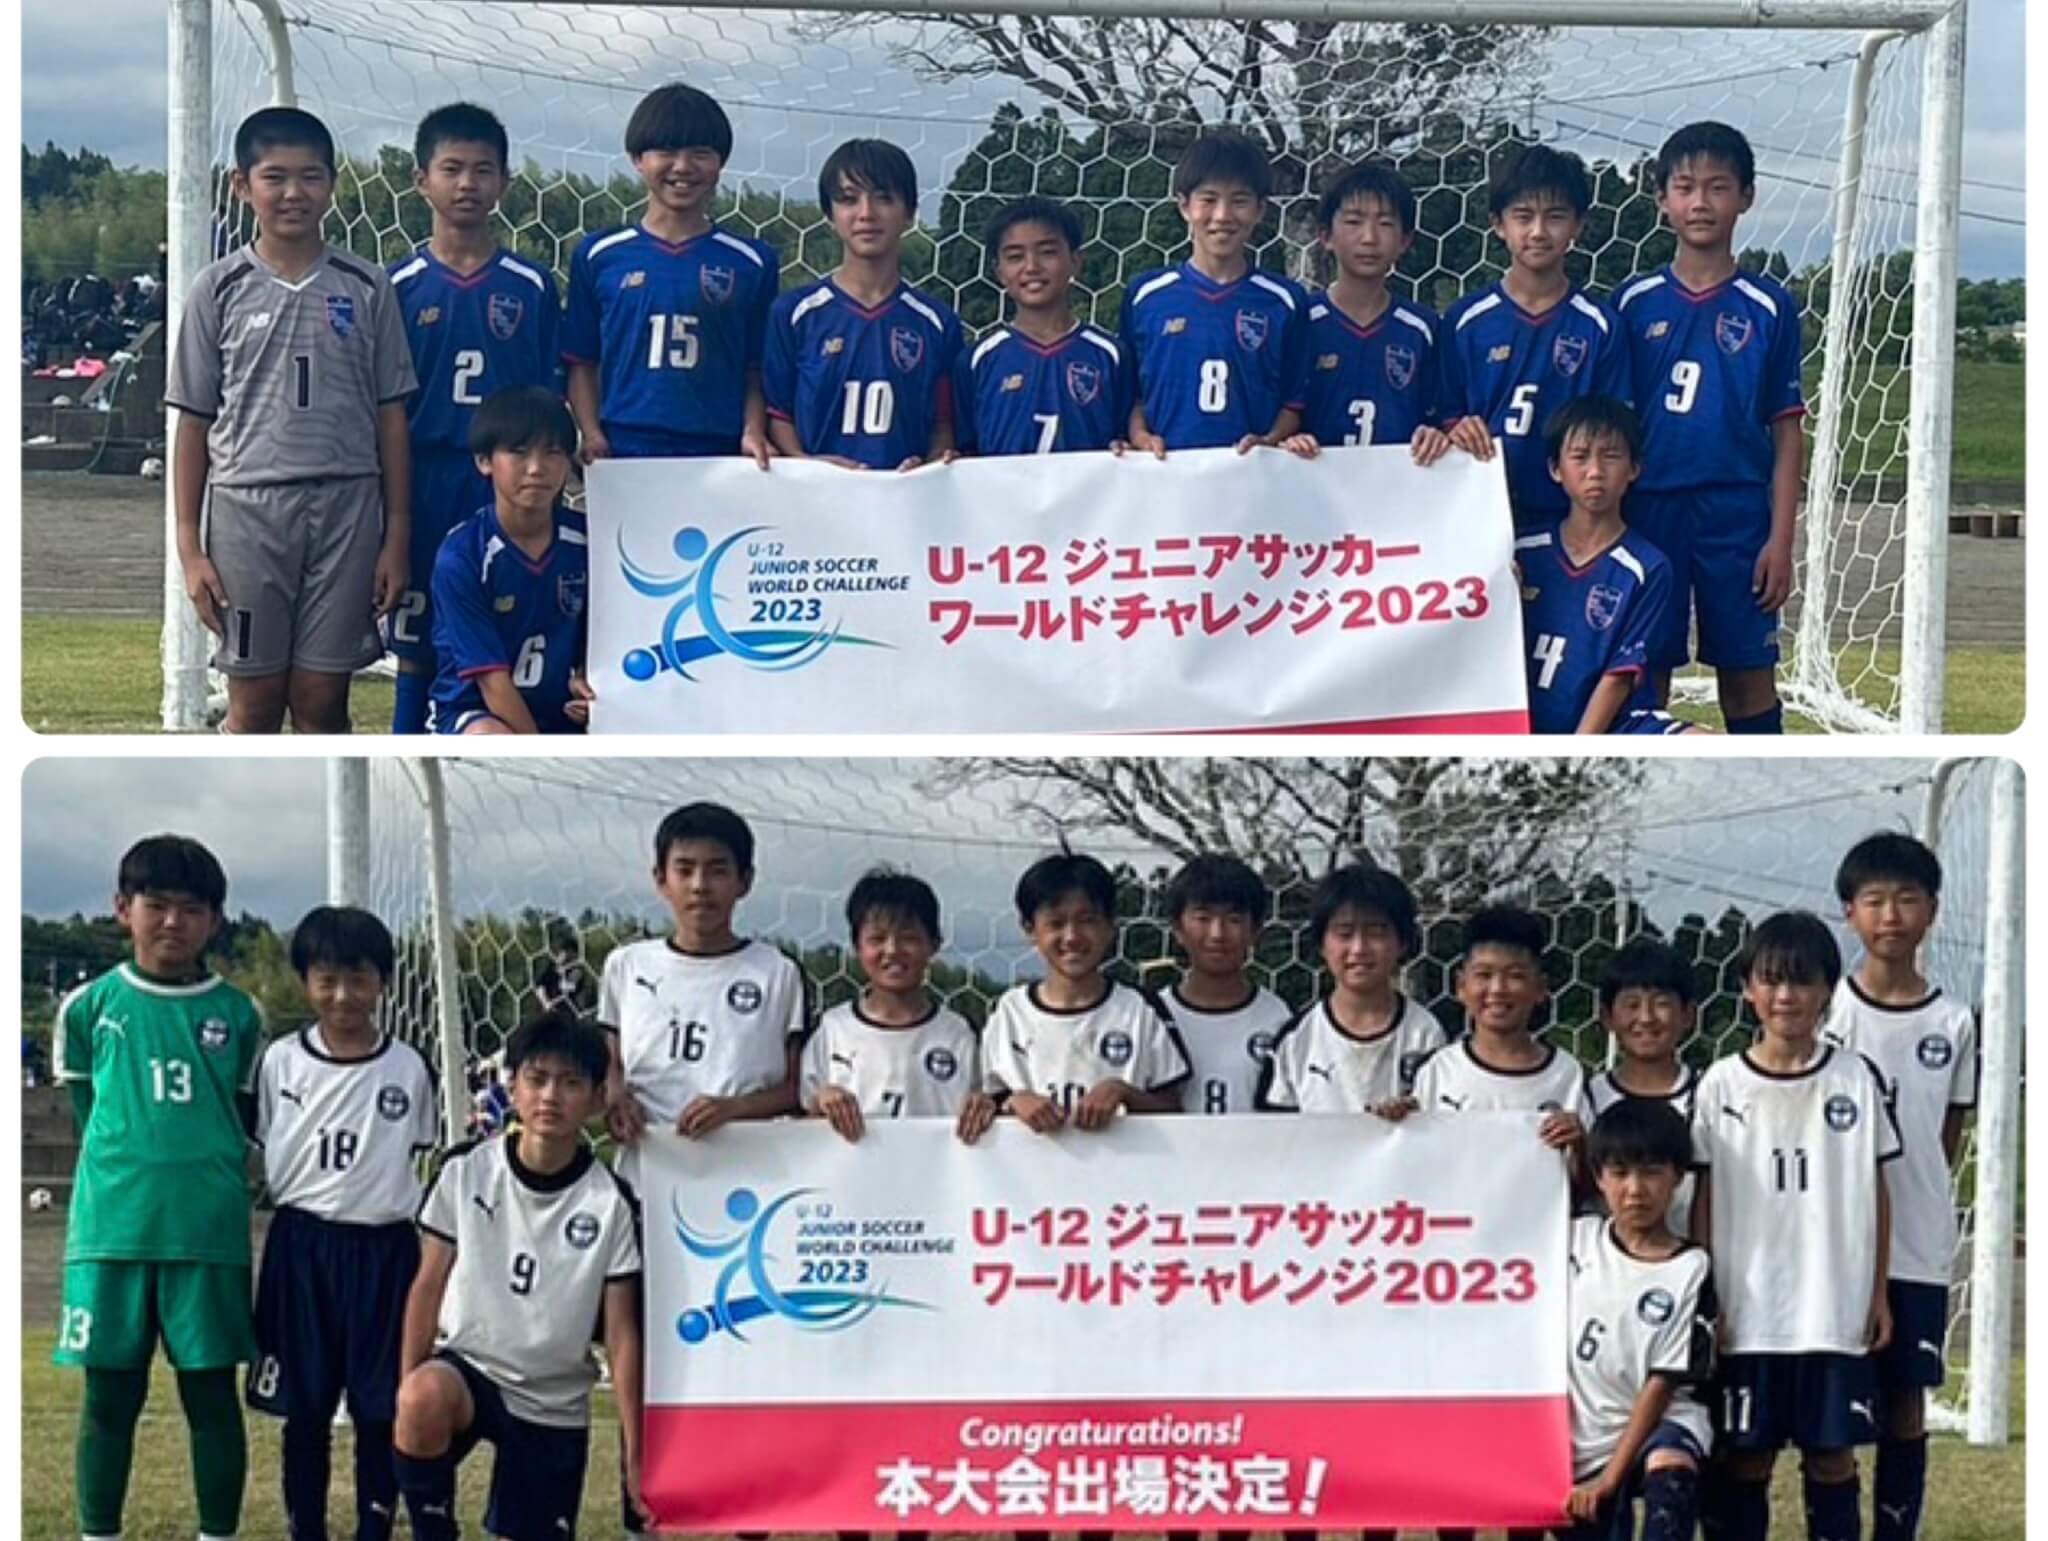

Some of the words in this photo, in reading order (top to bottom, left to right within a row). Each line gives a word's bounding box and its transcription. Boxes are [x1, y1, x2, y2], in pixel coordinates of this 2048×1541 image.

[647, 314, 699, 369] 15
[294, 356, 310, 408] 1
[453, 351, 484, 404] 2
[1199, 359, 1229, 412] 8
[1664, 361, 1701, 413] 9
[841, 380, 894, 434] 10
[1344, 400, 1375, 446] 3
[1504, 384, 1539, 436] 5
[1032, 414, 1060, 453] 7
[747, 543, 784, 557] U-12
[748, 560, 809, 576] JUNIOR
[814, 558, 877, 574] SOCCER
[928, 545, 1048, 585] U-12
[1063, 533, 1420, 585] ジュニアサッカー
[748, 577, 808, 594] WORLD
[812, 575, 911, 593] CHALLENGE
[395, 590, 426, 642] 2
[750, 599, 822, 623] 2023
[929, 575, 1490, 646] ワールドチャレンジ2023
[235, 610, 252, 659] 1
[513, 636, 547, 687] 6
[1533, 634, 1566, 689] 4
[668, 1018, 706, 1061] 16
[148, 1060, 191, 1102] 13
[317, 1129, 358, 1170] 18
[1772, 1148, 1809, 1191] 11
[796, 1240, 857, 1255] WORLD
[860, 1239, 954, 1254] CHALLENGE
[862, 1221, 925, 1235] SOCCER
[972, 1209, 1090, 1247] U-12
[1106, 1202, 1473, 1249] ジュニアサッカー
[511, 1254, 536, 1295] 9
[799, 1260, 869, 1283] 2023
[972, 1258, 1537, 1307] ワールドチャレンジ2023
[60, 1305, 93, 1349] 13
[1576, 1318, 1605, 1362] 6
[1721, 1387, 1752, 1433] 11
[960, 1415, 1244, 1456] Congraturations!
